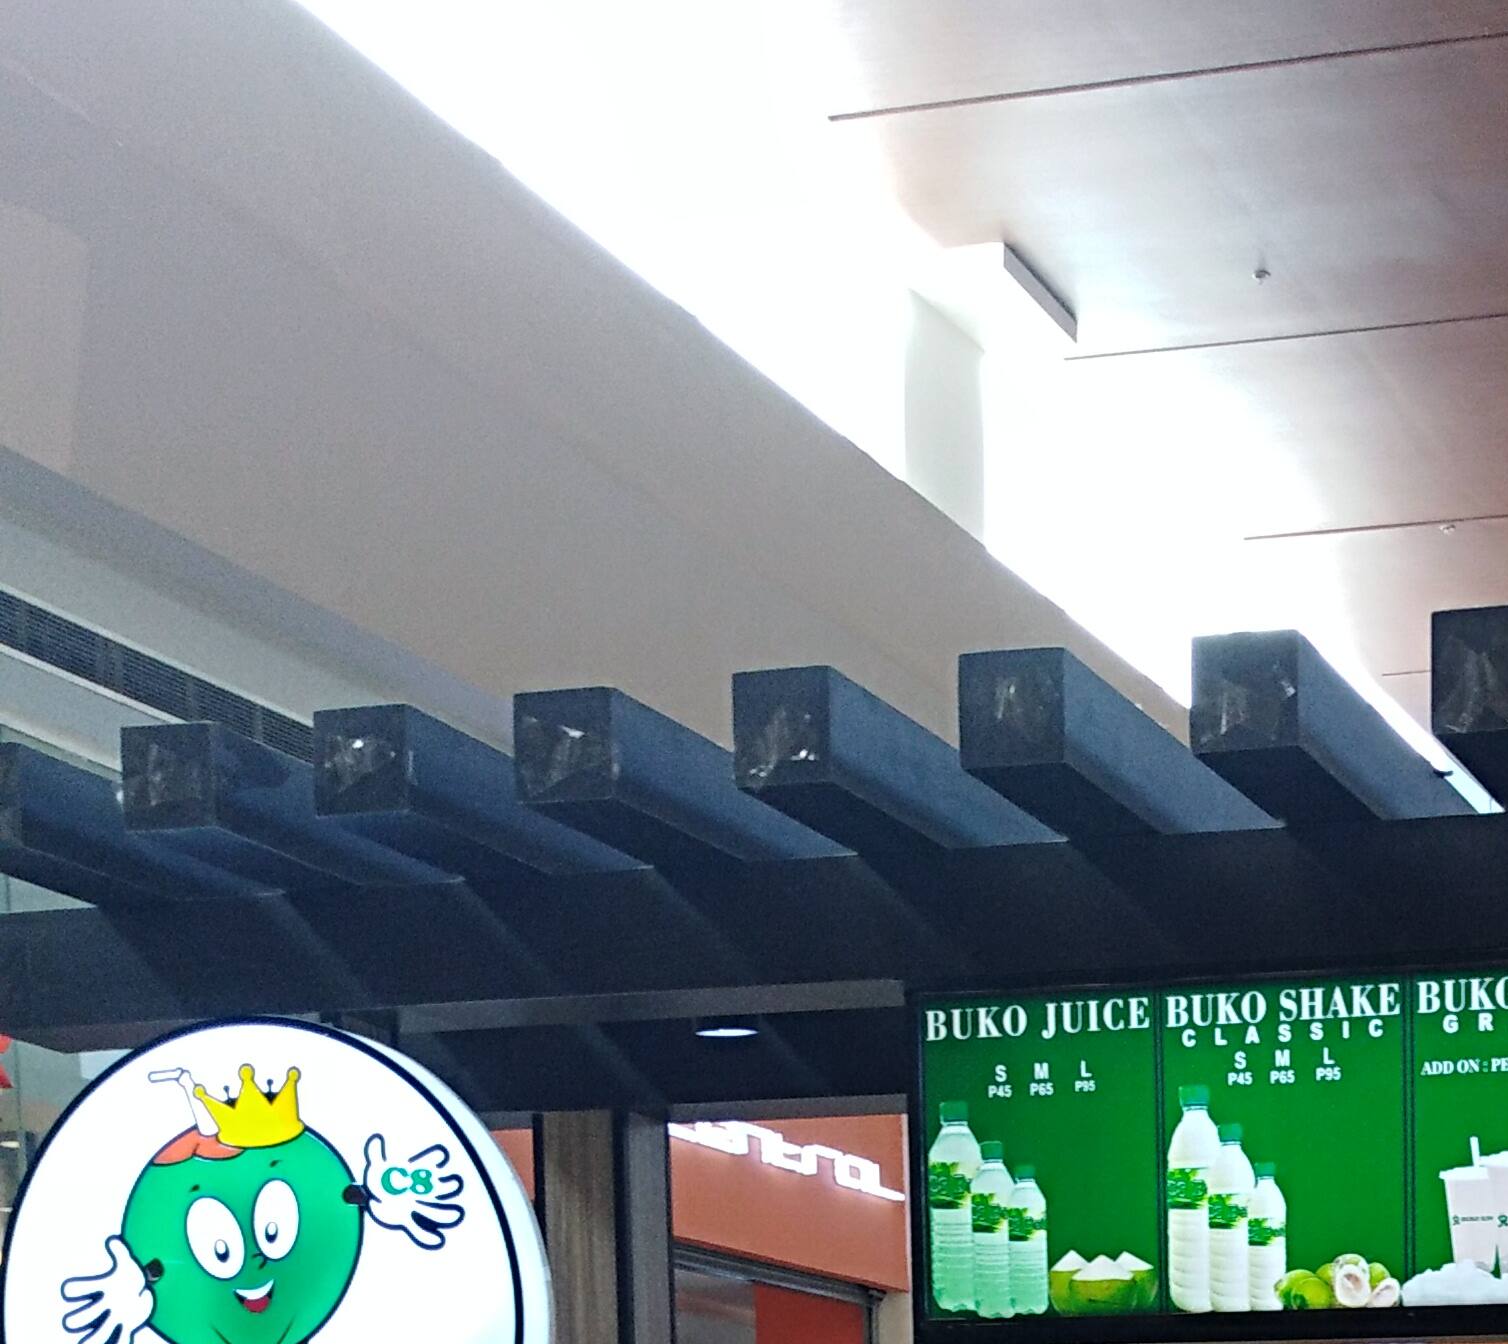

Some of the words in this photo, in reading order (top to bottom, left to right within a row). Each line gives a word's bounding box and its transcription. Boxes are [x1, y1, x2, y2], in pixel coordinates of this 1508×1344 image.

[1166, 991, 1267, 1027] BUKO
[1279, 983, 1400, 1021] SHAKE
[926, 1005, 1027, 1041] BUKO
[1041, 997, 1150, 1040] JUICE
[1182, 1019, 1383, 1047] CLASSIC
[1234, 1051, 1247, 1070] S
[1275, 1049, 1290, 1067] M
[1323, 1047, 1335, 1064] L
[1421, 1060, 1454, 1076] ADD
[1456, 1059, 1480, 1073] ON
[995, 1064, 1007, 1082] S
[1034, 1062, 1049, 1080] M
[1080, 1060, 1092, 1078] L
[1228, 1072, 1253, 1086] P45
[1270, 1070, 1295, 1084] P65
[1316, 1067, 1341, 1081] P95
[988, 1085, 1012, 1098] P45
[1030, 1083, 1054, 1096] P65
[1075, 1080, 1095, 1092] P95
[381, 1167, 434, 1196] C8
